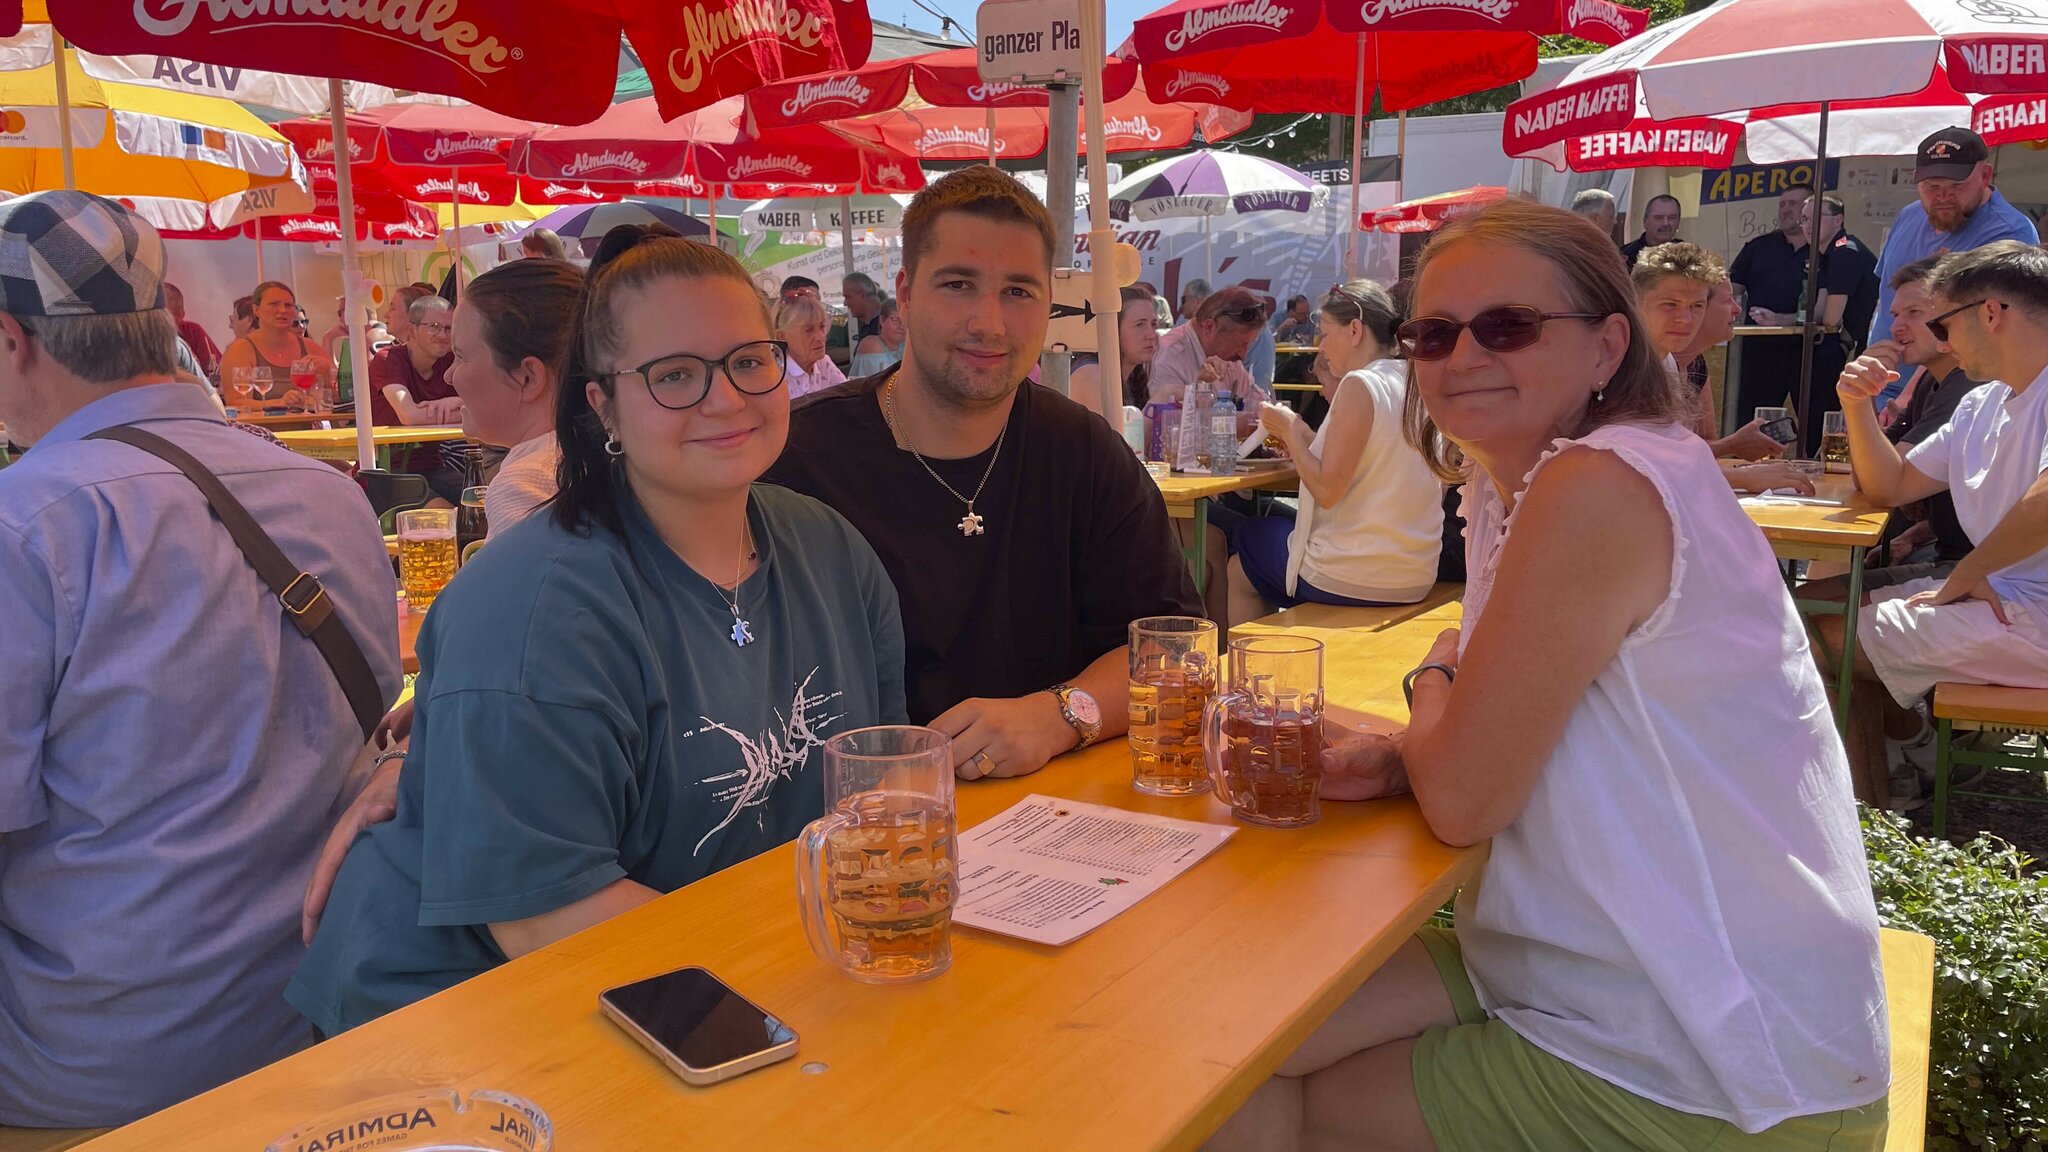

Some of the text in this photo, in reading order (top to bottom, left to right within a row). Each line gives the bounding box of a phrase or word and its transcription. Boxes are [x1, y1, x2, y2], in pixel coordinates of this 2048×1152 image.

[984, 20, 1080, 63] ganzer Pla
[1165, 0, 1288, 51] Almdudler
[668, 0, 822, 93] Almdudler
[1961, 43, 2046, 75] NABER
[781, 75, 868, 117] Almdudler
[1514, 97, 1575, 139] NABER
[561, 149, 648, 177] Almdudler
[727, 153, 813, 181] Almdudler
[1709, 165, 1826, 200] APERO
[758, 209, 885, 227] NABER KFFEE
